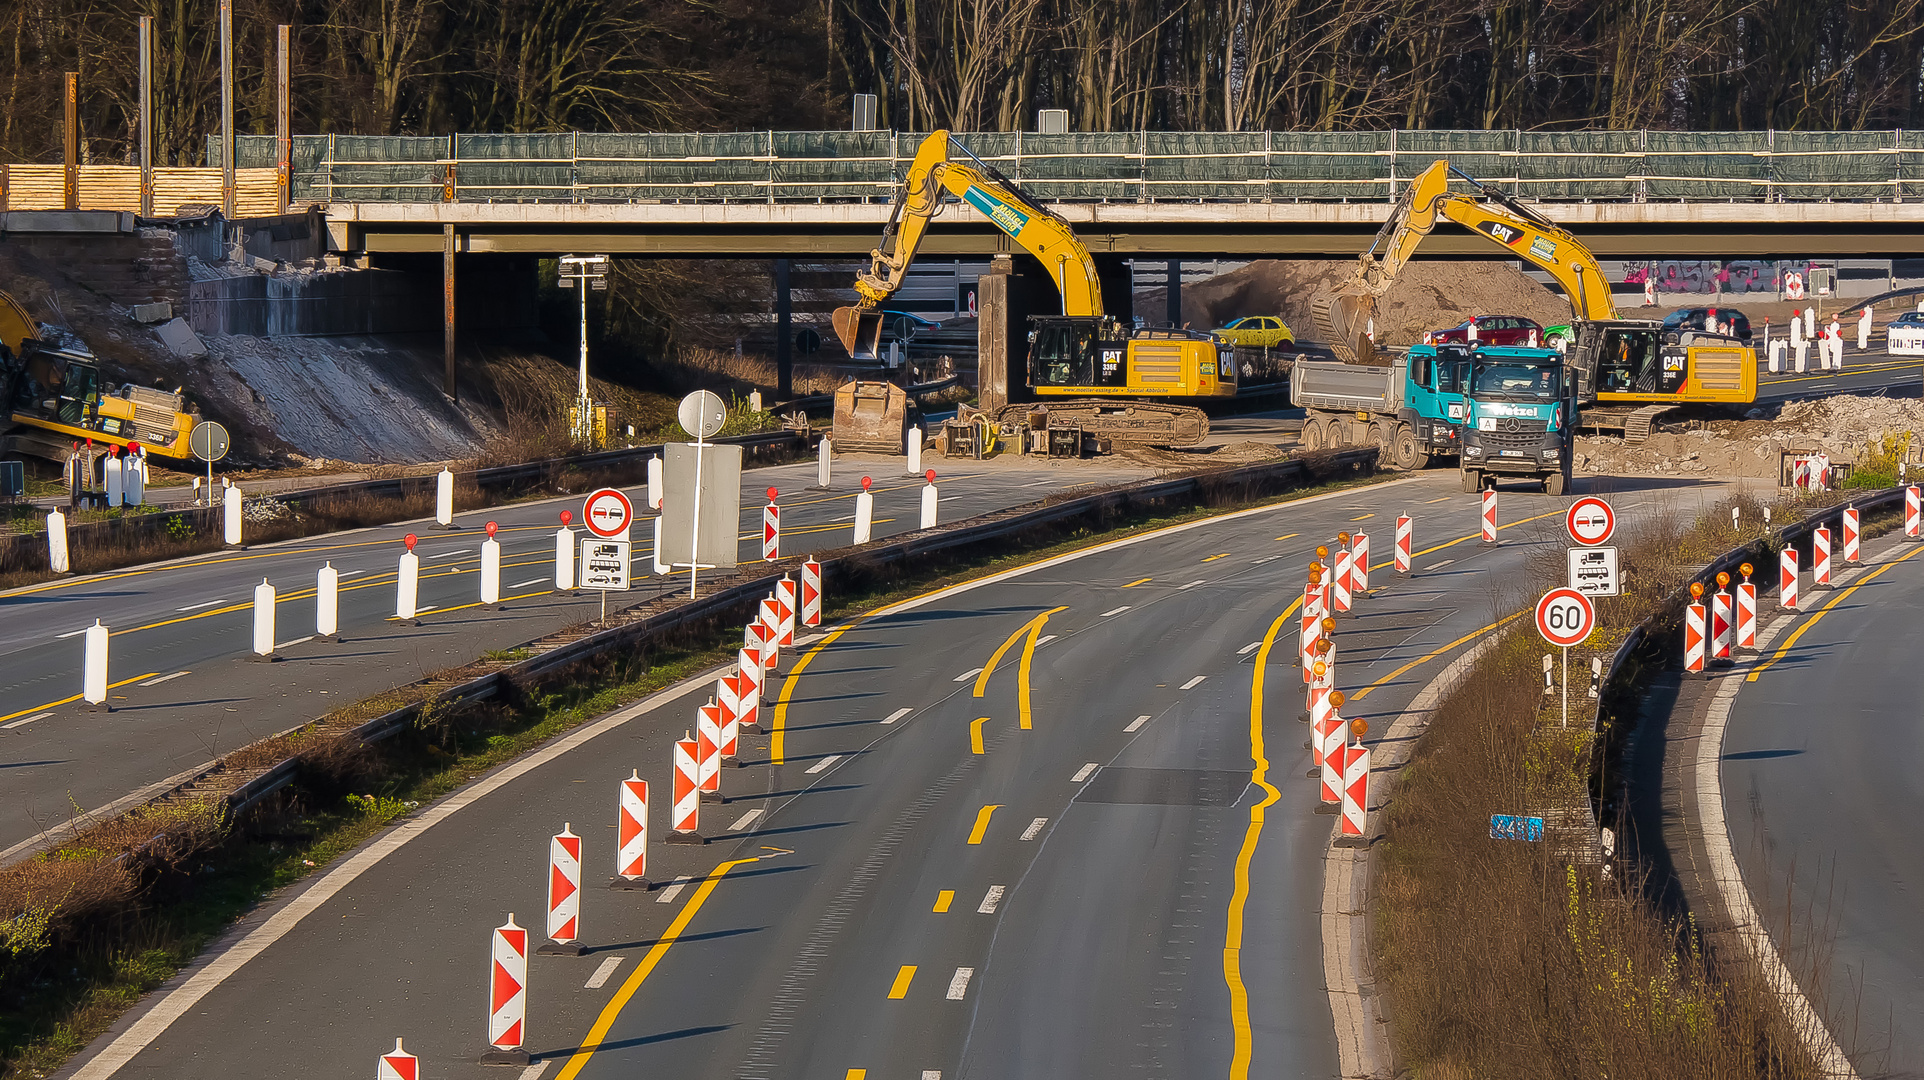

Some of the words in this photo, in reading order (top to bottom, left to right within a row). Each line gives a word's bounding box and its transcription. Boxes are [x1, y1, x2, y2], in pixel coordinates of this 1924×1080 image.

[278, 173, 287, 186] 8
[67, 182, 74, 195] 5
[142, 182, 149, 195] 6
[225, 187, 232, 201] 7
[445, 186, 453, 199] 9
[991, 208, 1017, 232] Essing
[997, 203, 1025, 226] Möller
[1491, 223, 1514, 243] CAT
[1102, 351, 1122, 364] CAT
[1220, 351, 1234, 376] CAT
[1663, 356, 1686, 371] CAT
[1102, 363, 1118, 371] 336E
[1452, 407, 1460, 416] A
[1486, 403, 1538, 417] Wetzel
[1484, 420, 1492, 429] A
[1549, 604, 1581, 630] 60
